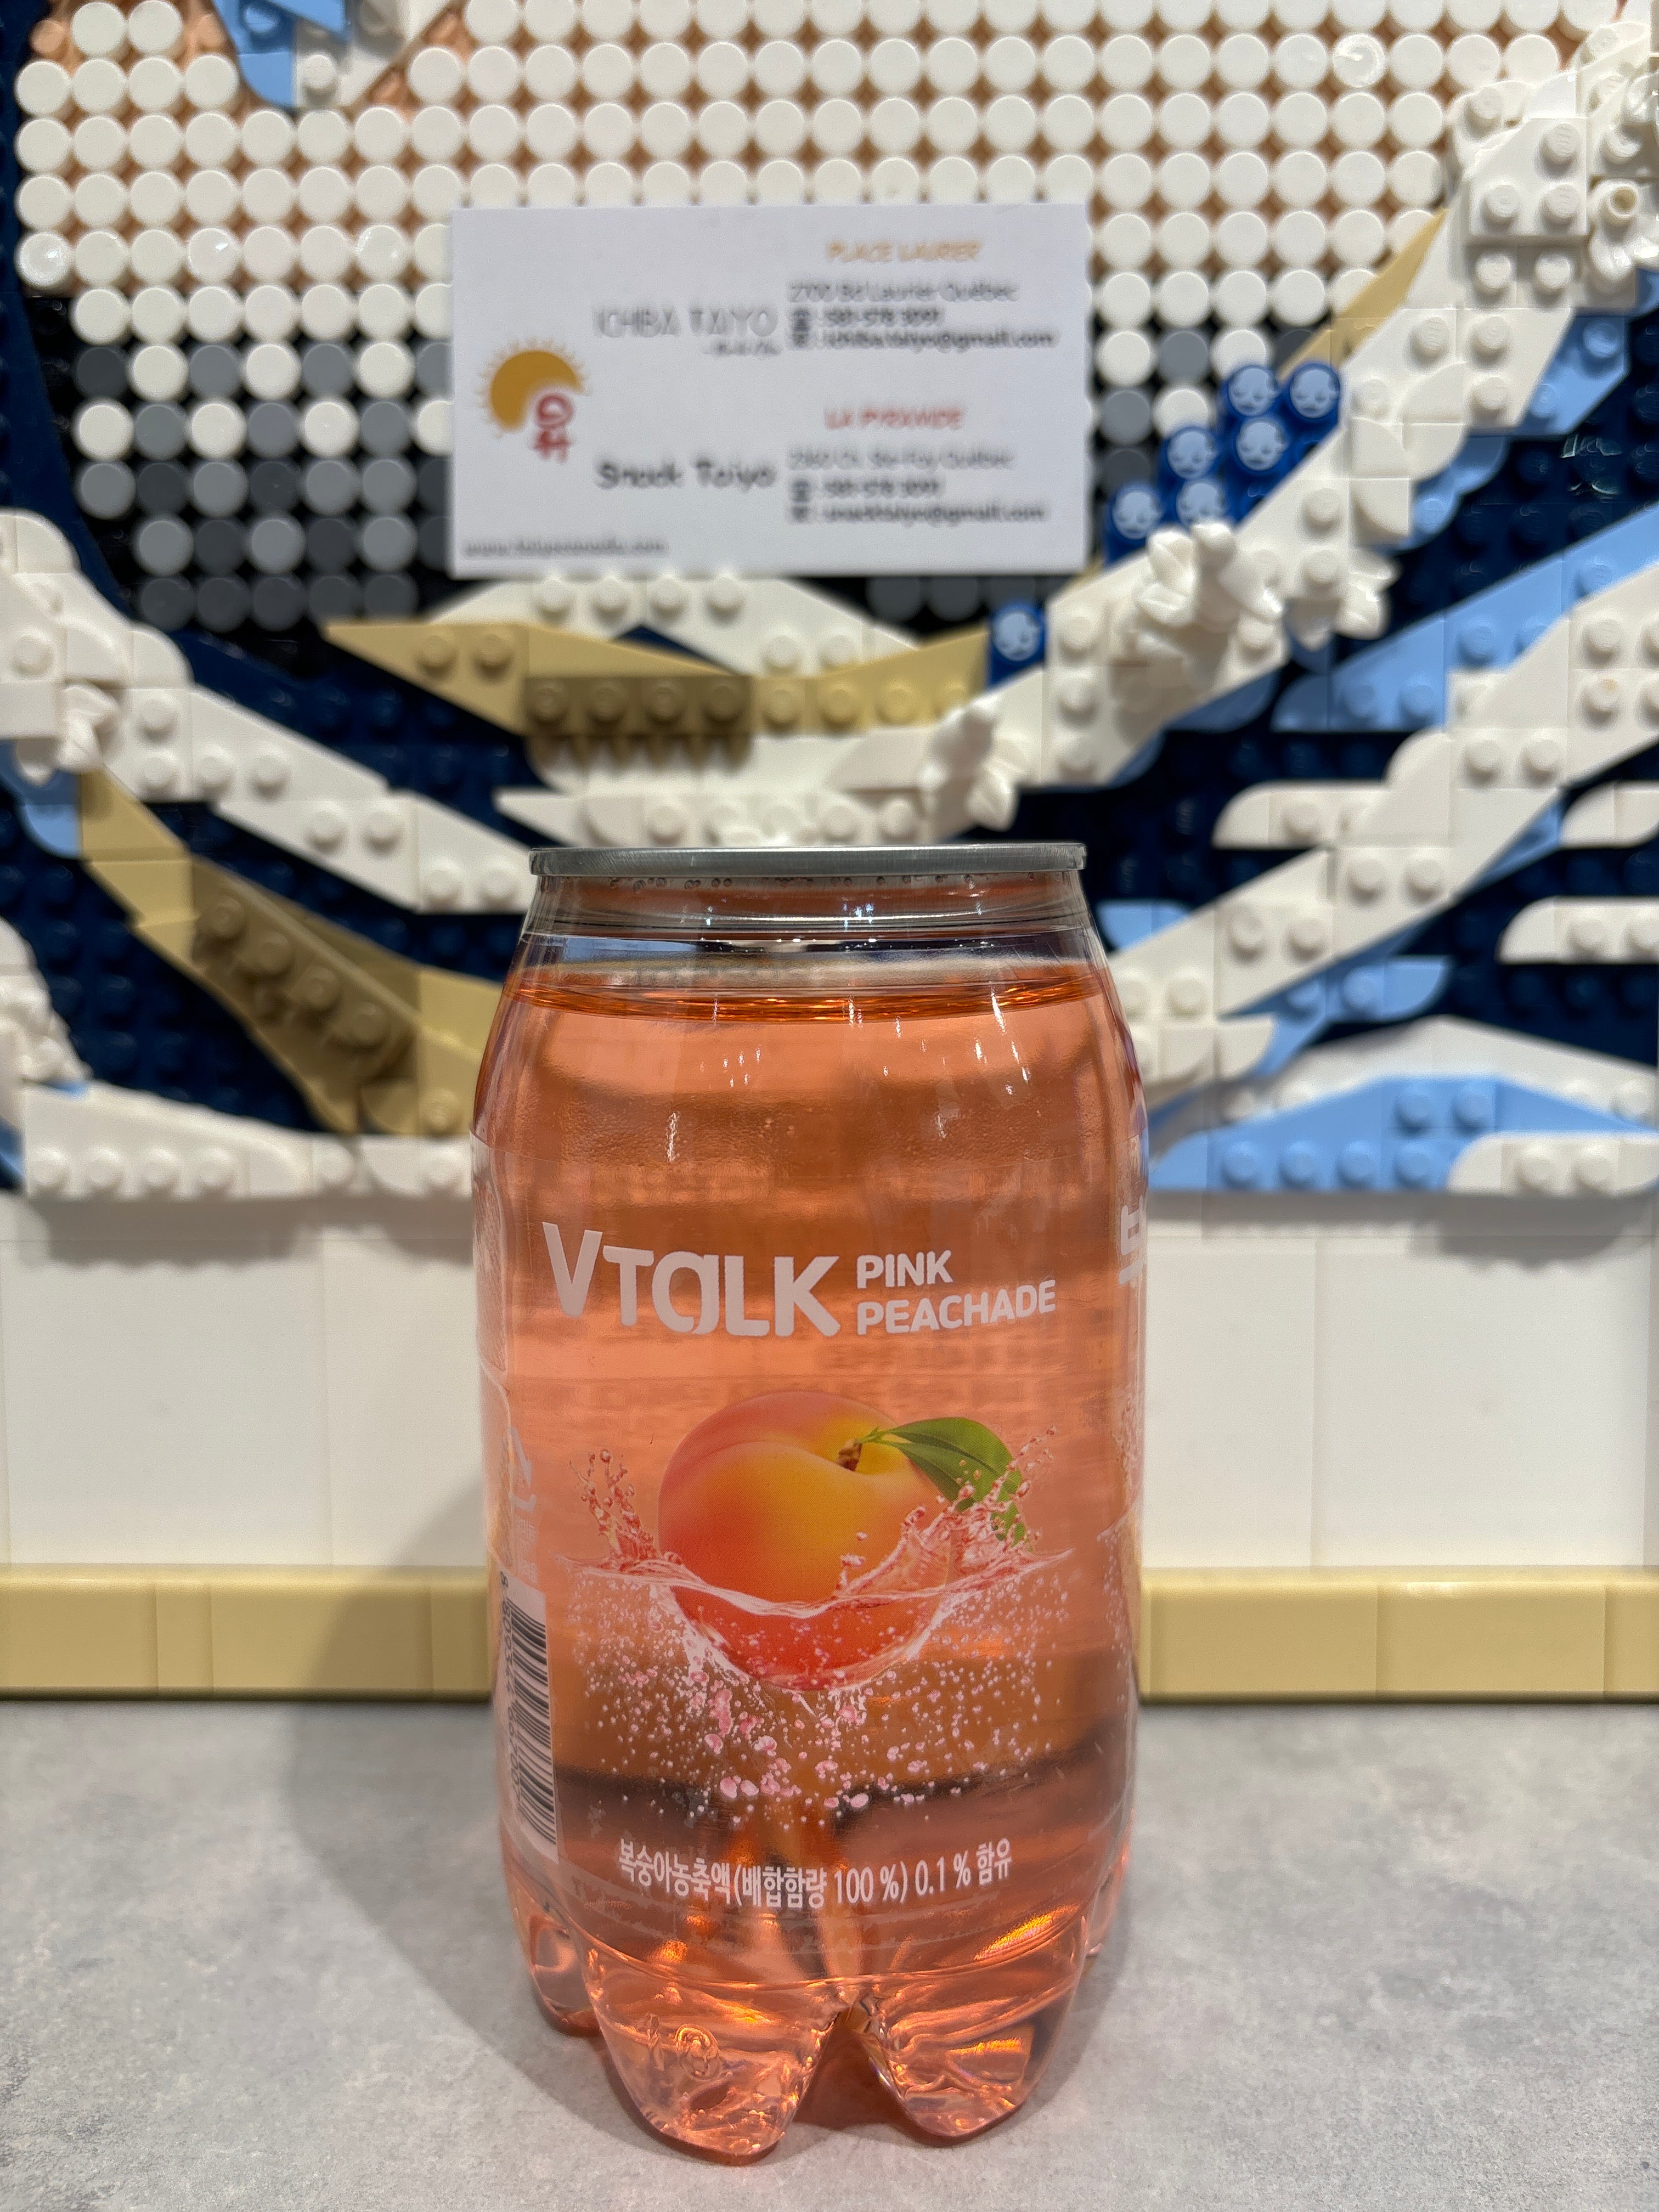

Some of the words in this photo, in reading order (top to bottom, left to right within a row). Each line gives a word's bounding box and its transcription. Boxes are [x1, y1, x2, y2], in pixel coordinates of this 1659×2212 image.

[688, 305, 779, 337] TAIYO
[856, 1250, 952, 1289] PINK
[856, 1279, 1057, 1335] PEACHADE
[834, 1866, 874, 1904] 100
[976, 1837, 1012, 1886] 함유
